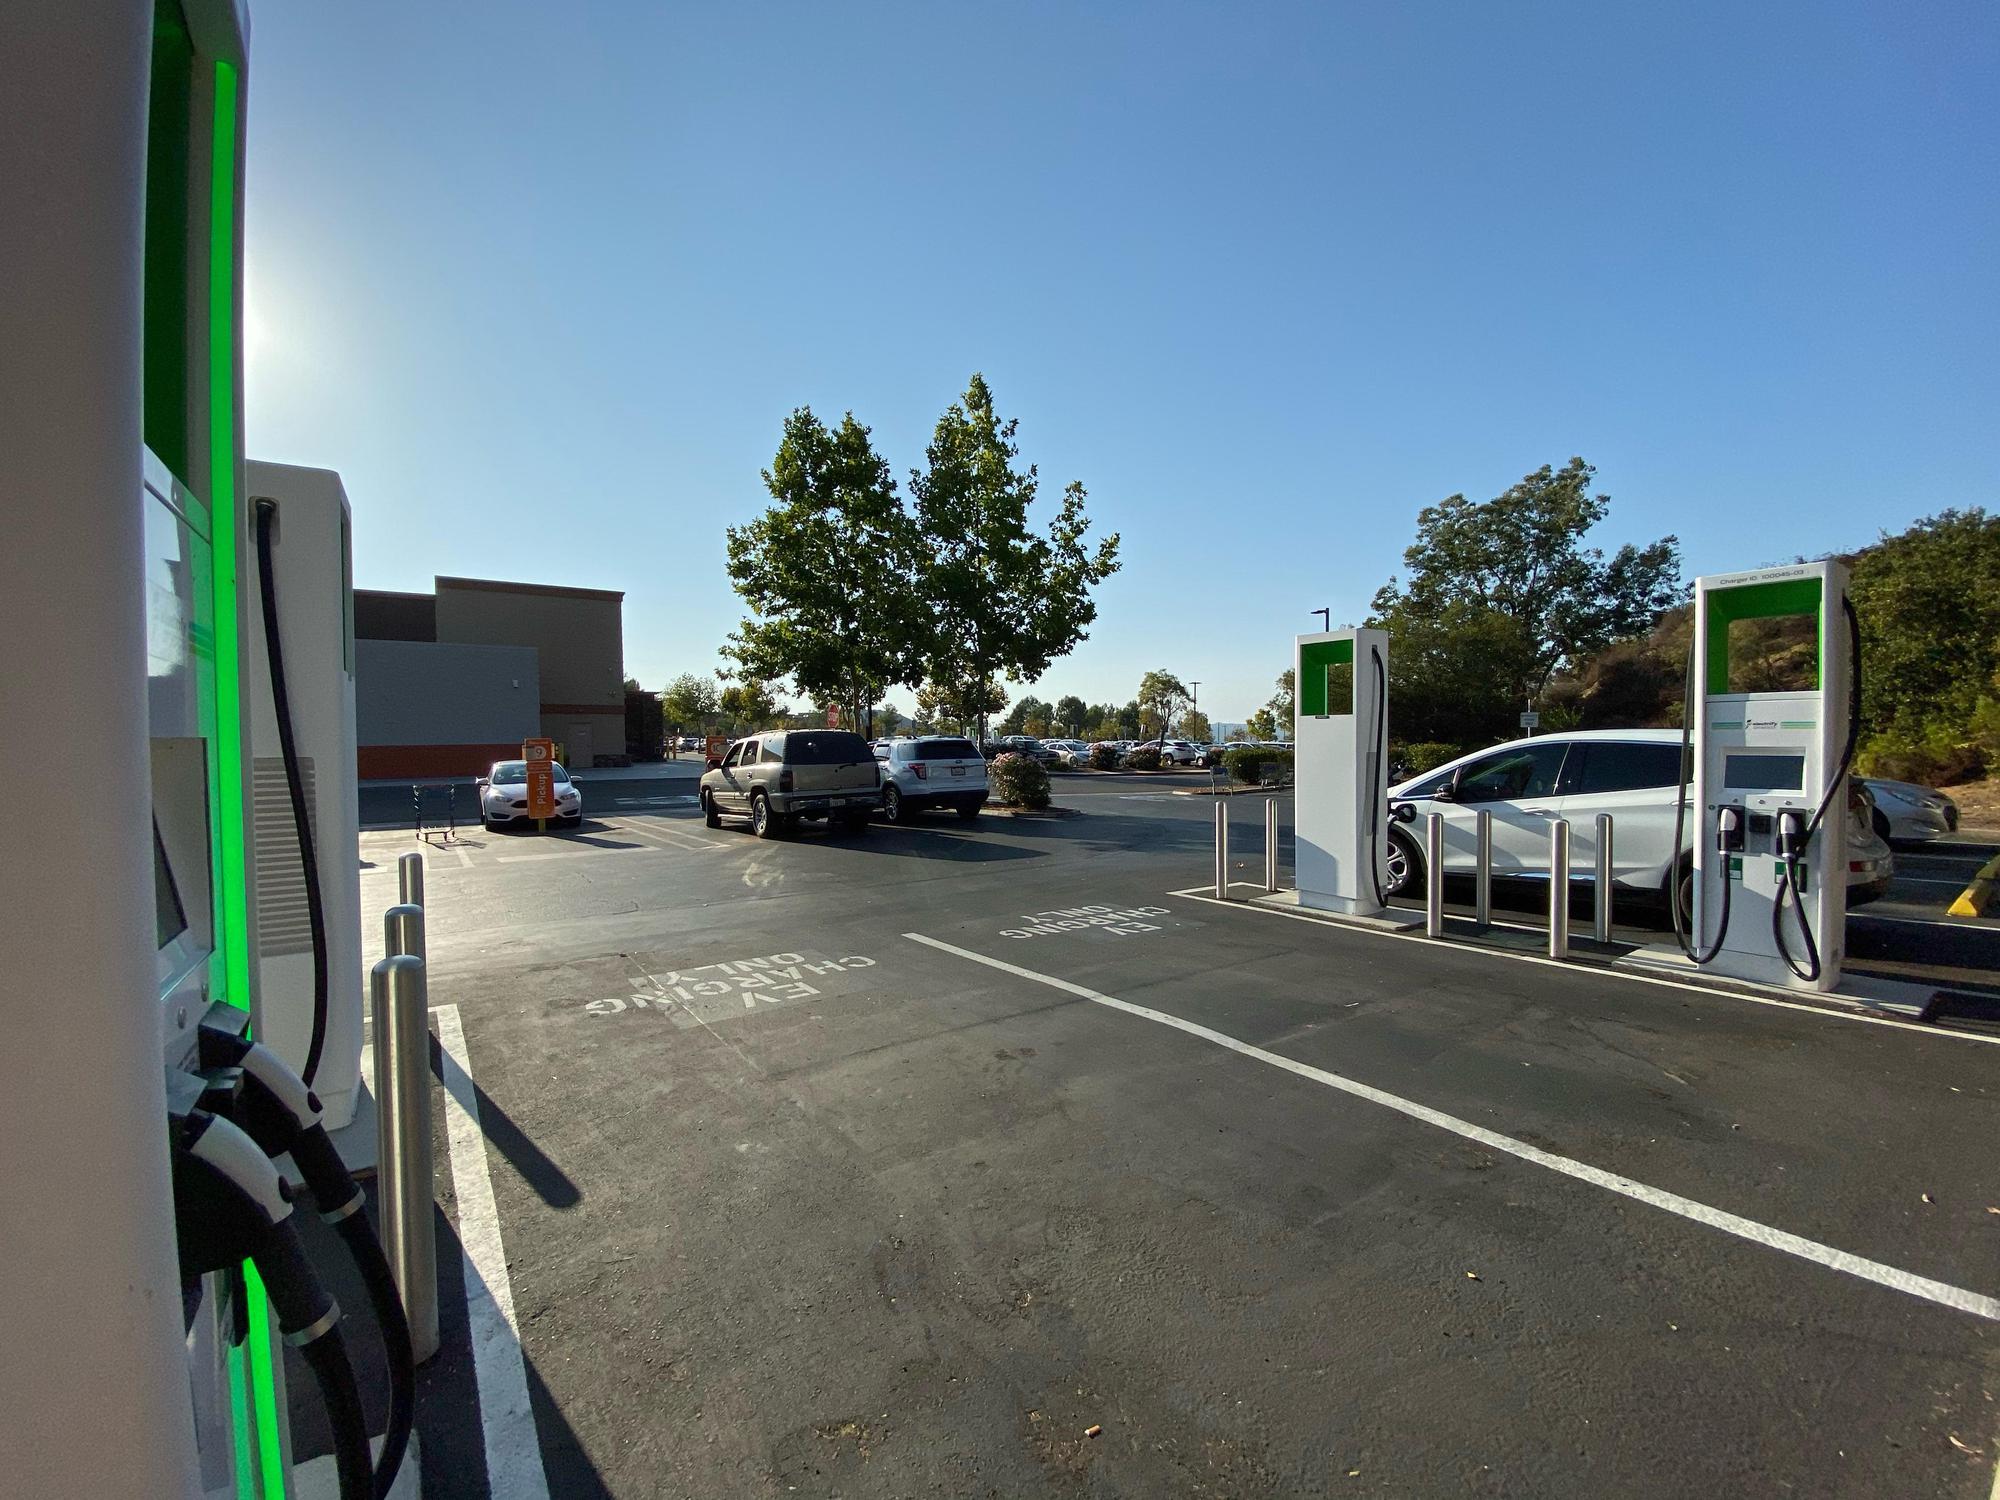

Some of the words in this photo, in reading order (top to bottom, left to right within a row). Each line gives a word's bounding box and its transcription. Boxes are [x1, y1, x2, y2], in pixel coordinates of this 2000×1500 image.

[1720, 577, 1748, 585] Charger
[536, 774, 549, 805] Pickup
[998, 905, 1171, 939] CHARGING
[1020, 905, 1113, 923] ONLY
[1102, 921, 1163, 937] EV
[665, 952, 806, 985] ONLY
[584, 955, 876, 1016] CHARGING
[741, 981, 822, 1009] EV
